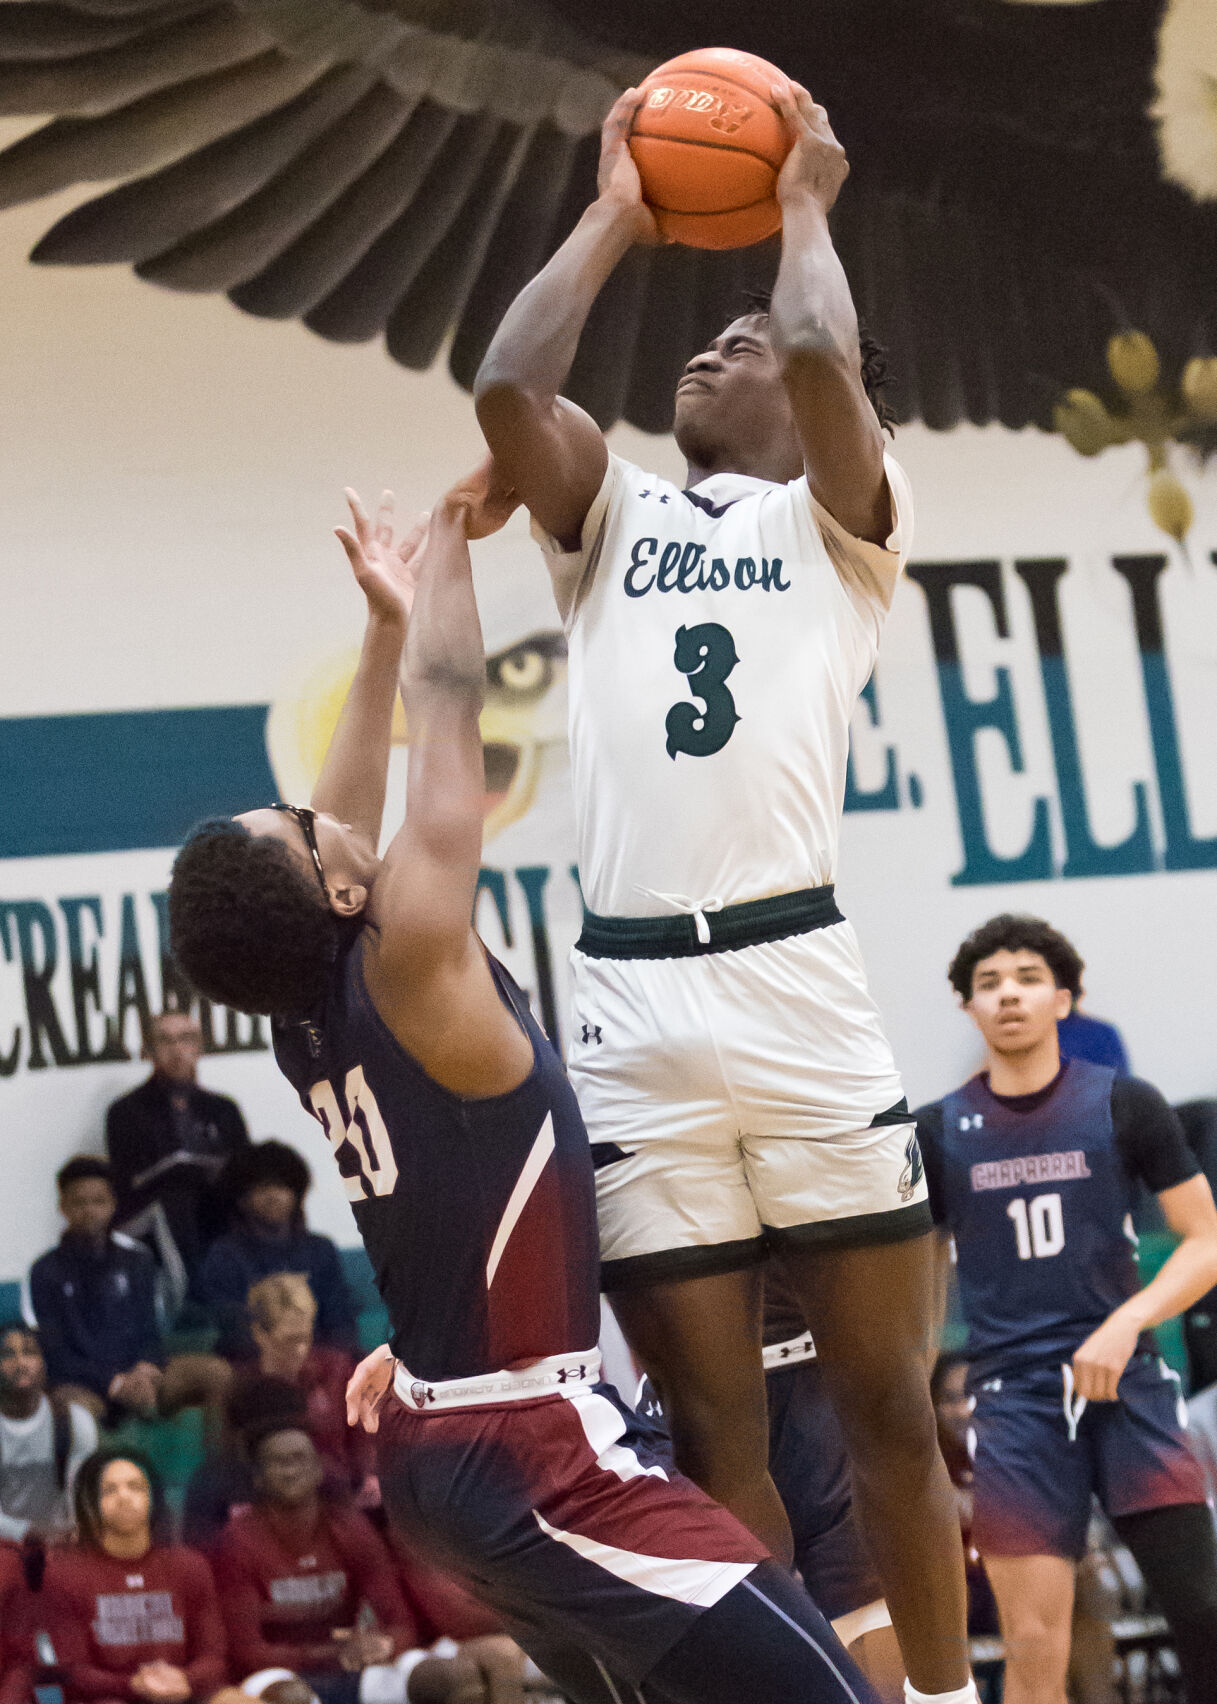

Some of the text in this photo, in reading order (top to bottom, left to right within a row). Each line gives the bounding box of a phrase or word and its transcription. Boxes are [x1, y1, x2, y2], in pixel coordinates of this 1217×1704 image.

[624, 537, 791, 598] Ellison
[665, 622, 742, 761] 3
[903, 552, 1217, 887] ELL
[309, 1064, 399, 1202] 20
[970, 1150, 1091, 1192] CHAPARRAL
[1006, 1193, 1065, 1260] 10
